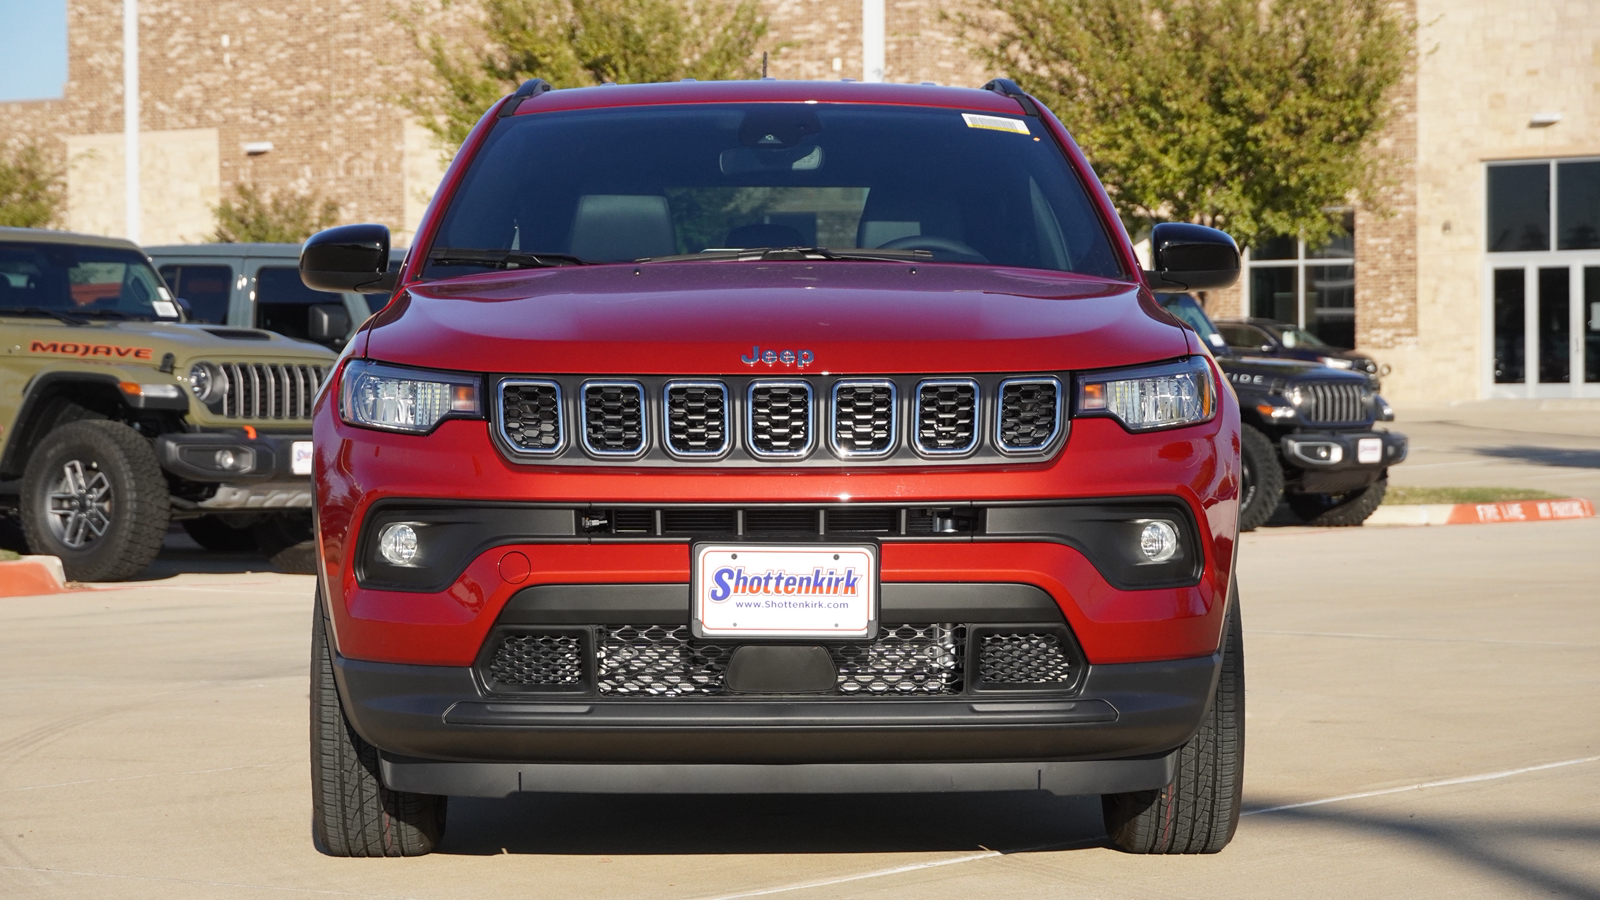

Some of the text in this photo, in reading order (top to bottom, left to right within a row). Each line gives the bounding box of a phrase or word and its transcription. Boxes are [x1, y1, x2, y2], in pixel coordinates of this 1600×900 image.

[30, 341, 153, 360] MOJAVE
[741, 345, 815, 368] Jeep
[710, 567, 860, 602] Shottenkirk
[735, 600, 849, 609] www.Shottenkirk.com
